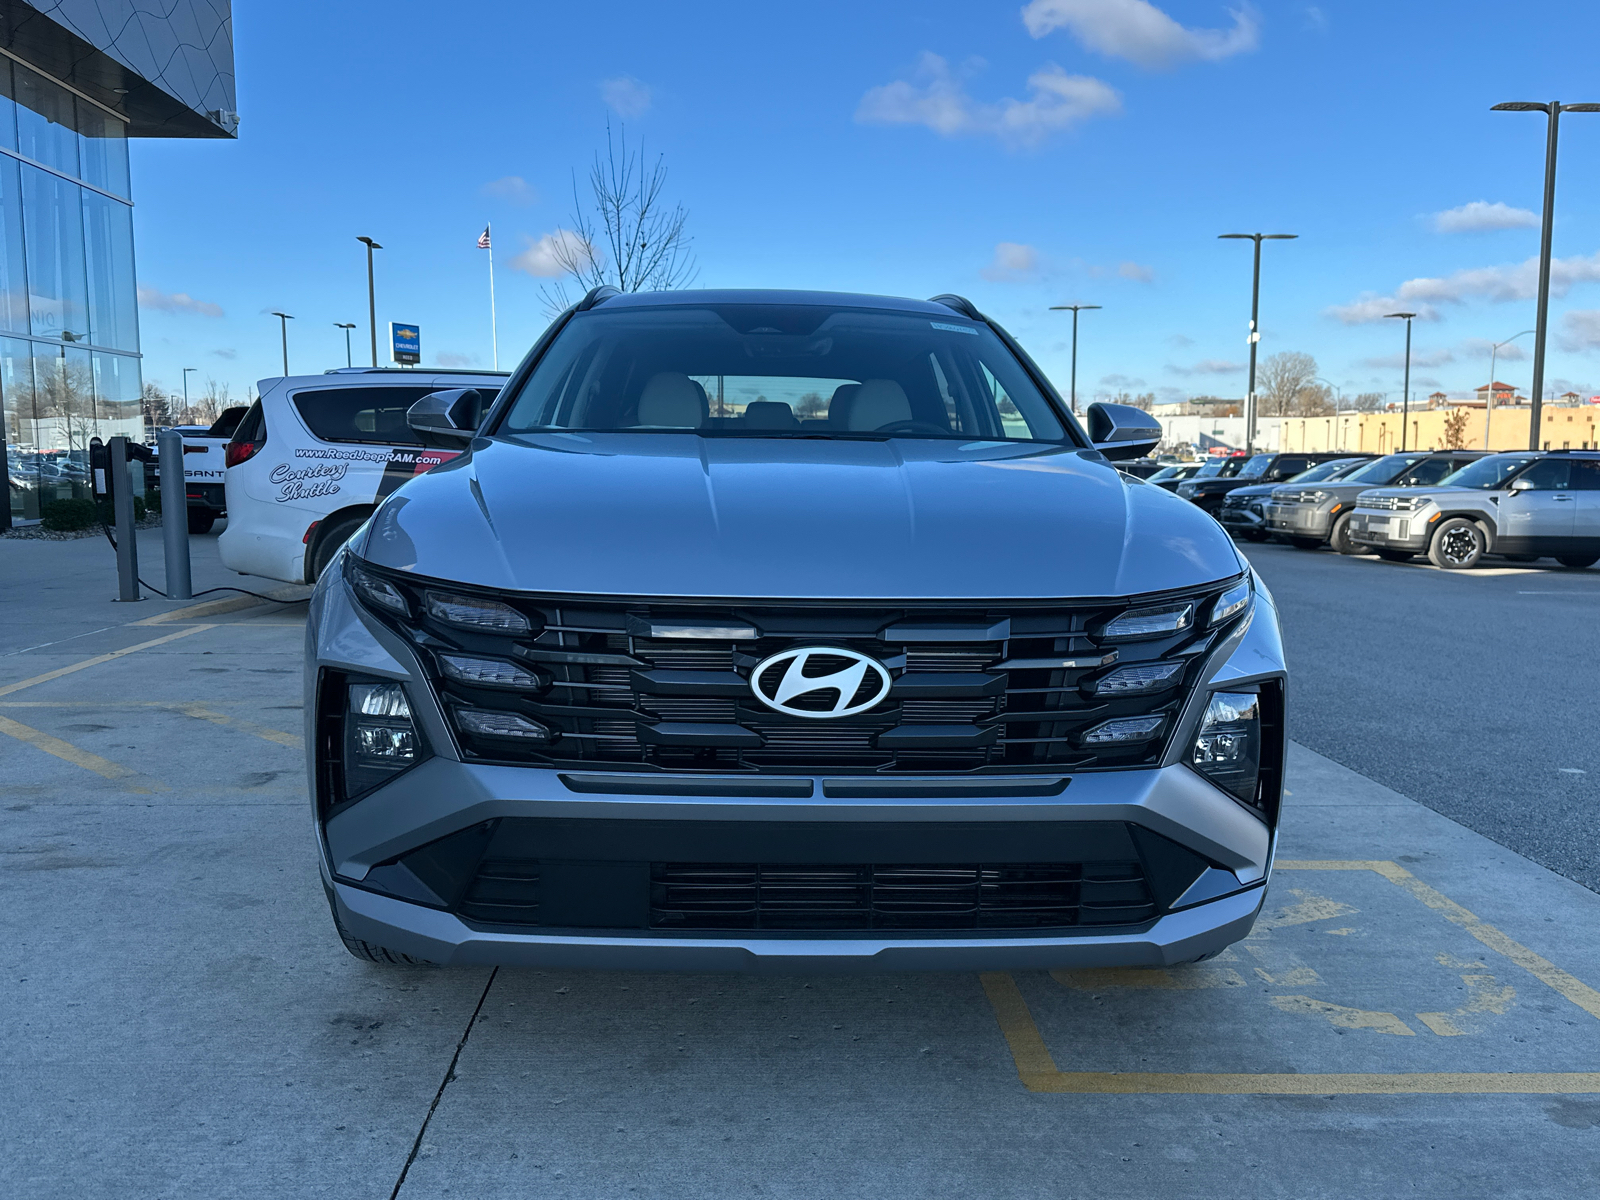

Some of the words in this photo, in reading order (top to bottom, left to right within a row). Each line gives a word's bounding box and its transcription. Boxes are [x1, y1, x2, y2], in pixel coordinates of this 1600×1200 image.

[295, 448, 442, 465] www.ReedJeepRAM.com
[269, 462, 349, 483] Courtesy
[275, 480, 340, 503] Shuttle
